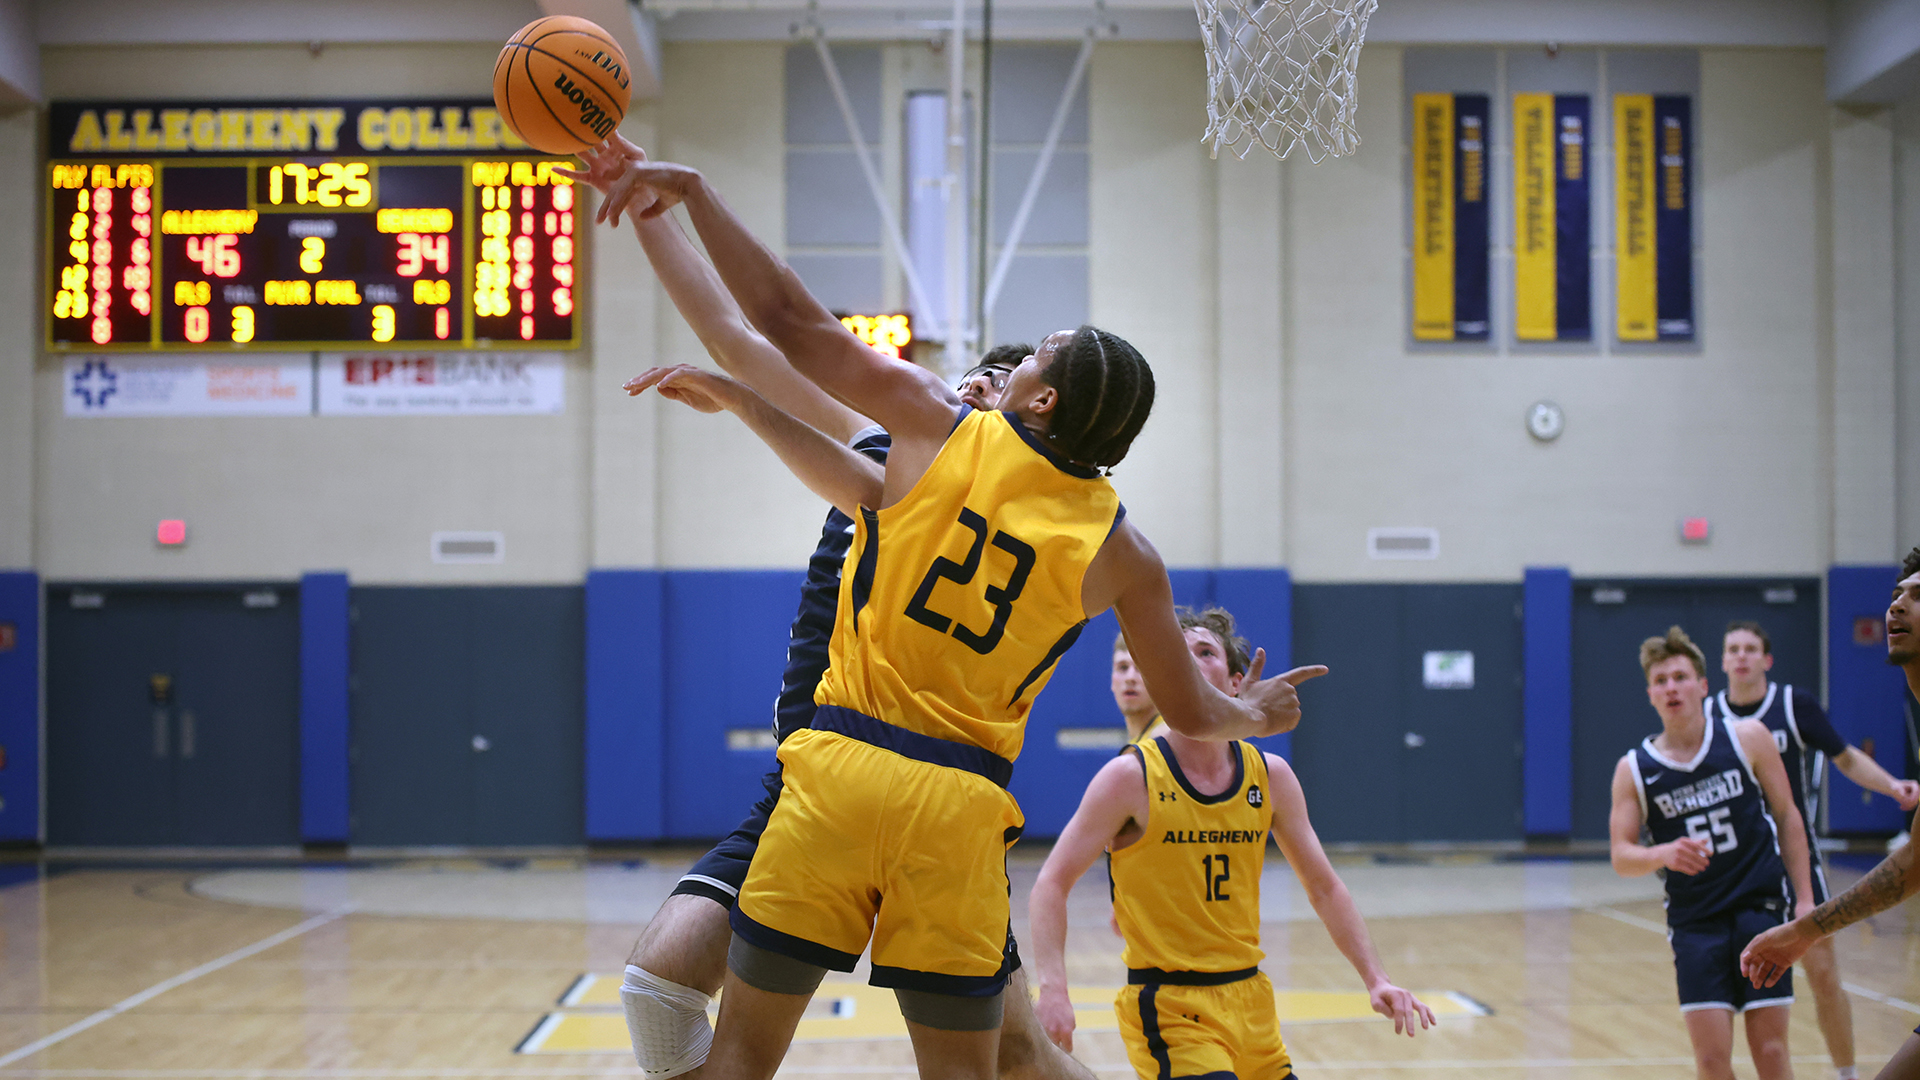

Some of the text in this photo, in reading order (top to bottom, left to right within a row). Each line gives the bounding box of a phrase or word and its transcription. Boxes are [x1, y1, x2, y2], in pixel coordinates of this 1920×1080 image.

[591, 51, 630, 90] EVO
[554, 73, 616, 139] Wilson
[69, 109, 345, 151] ALLEGHENY
[78, 188, 89, 212] 1
[269, 162, 371, 207] 17:25
[482, 185, 511, 210] 11
[521, 186, 535, 210] 1
[69, 212, 89, 240] 2
[521, 212, 535, 236] 1
[544, 212, 574, 236] 11
[69, 240, 89, 264] 4
[186, 233, 241, 277] 46
[300, 236, 325, 273] 2
[397, 233, 449, 276] 34
[521, 289, 535, 314] 1
[184, 306, 210, 343] 0
[231, 305, 255, 343] 3
[371, 304, 395, 342] 3
[435, 307, 449, 339] 1
[521, 315, 535, 340] 1
[903, 506, 1036, 655] 23
[1162, 831, 1263, 844] ALLEGHENY
[1685, 806, 1738, 855] 55
[1202, 854, 1230, 901] 12
